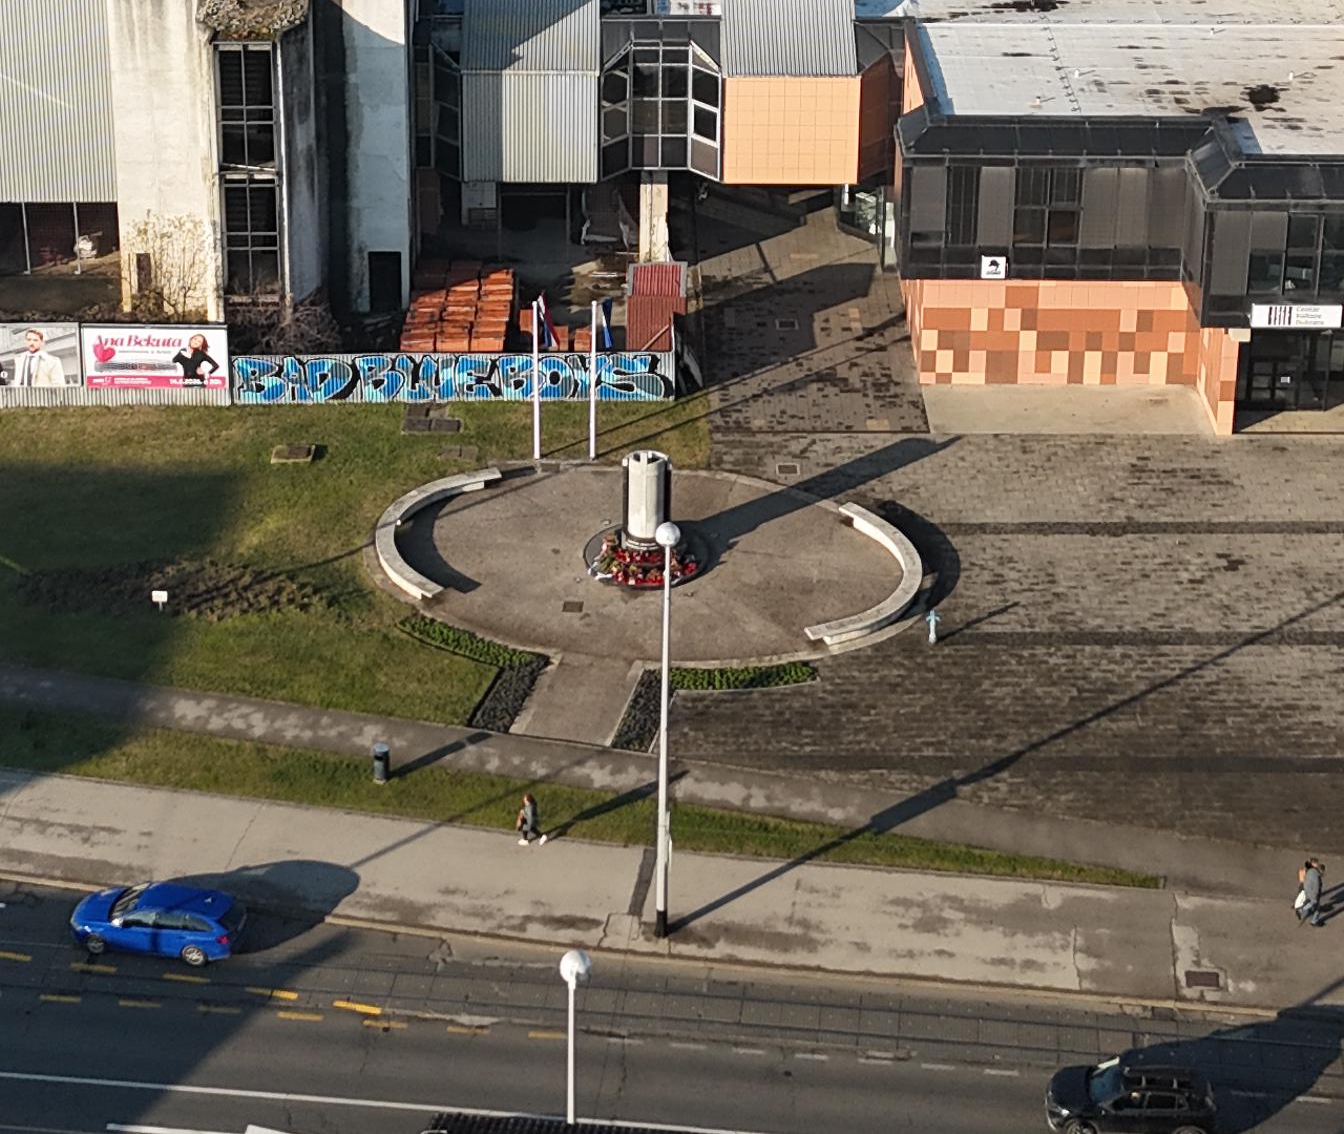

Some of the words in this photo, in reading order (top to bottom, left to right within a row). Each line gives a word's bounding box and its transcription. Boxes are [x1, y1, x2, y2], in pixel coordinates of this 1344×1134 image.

[233, 354, 360, 404] BAD
[355, 354, 503, 402] BLUE
[498, 354, 674, 401] BOYS
